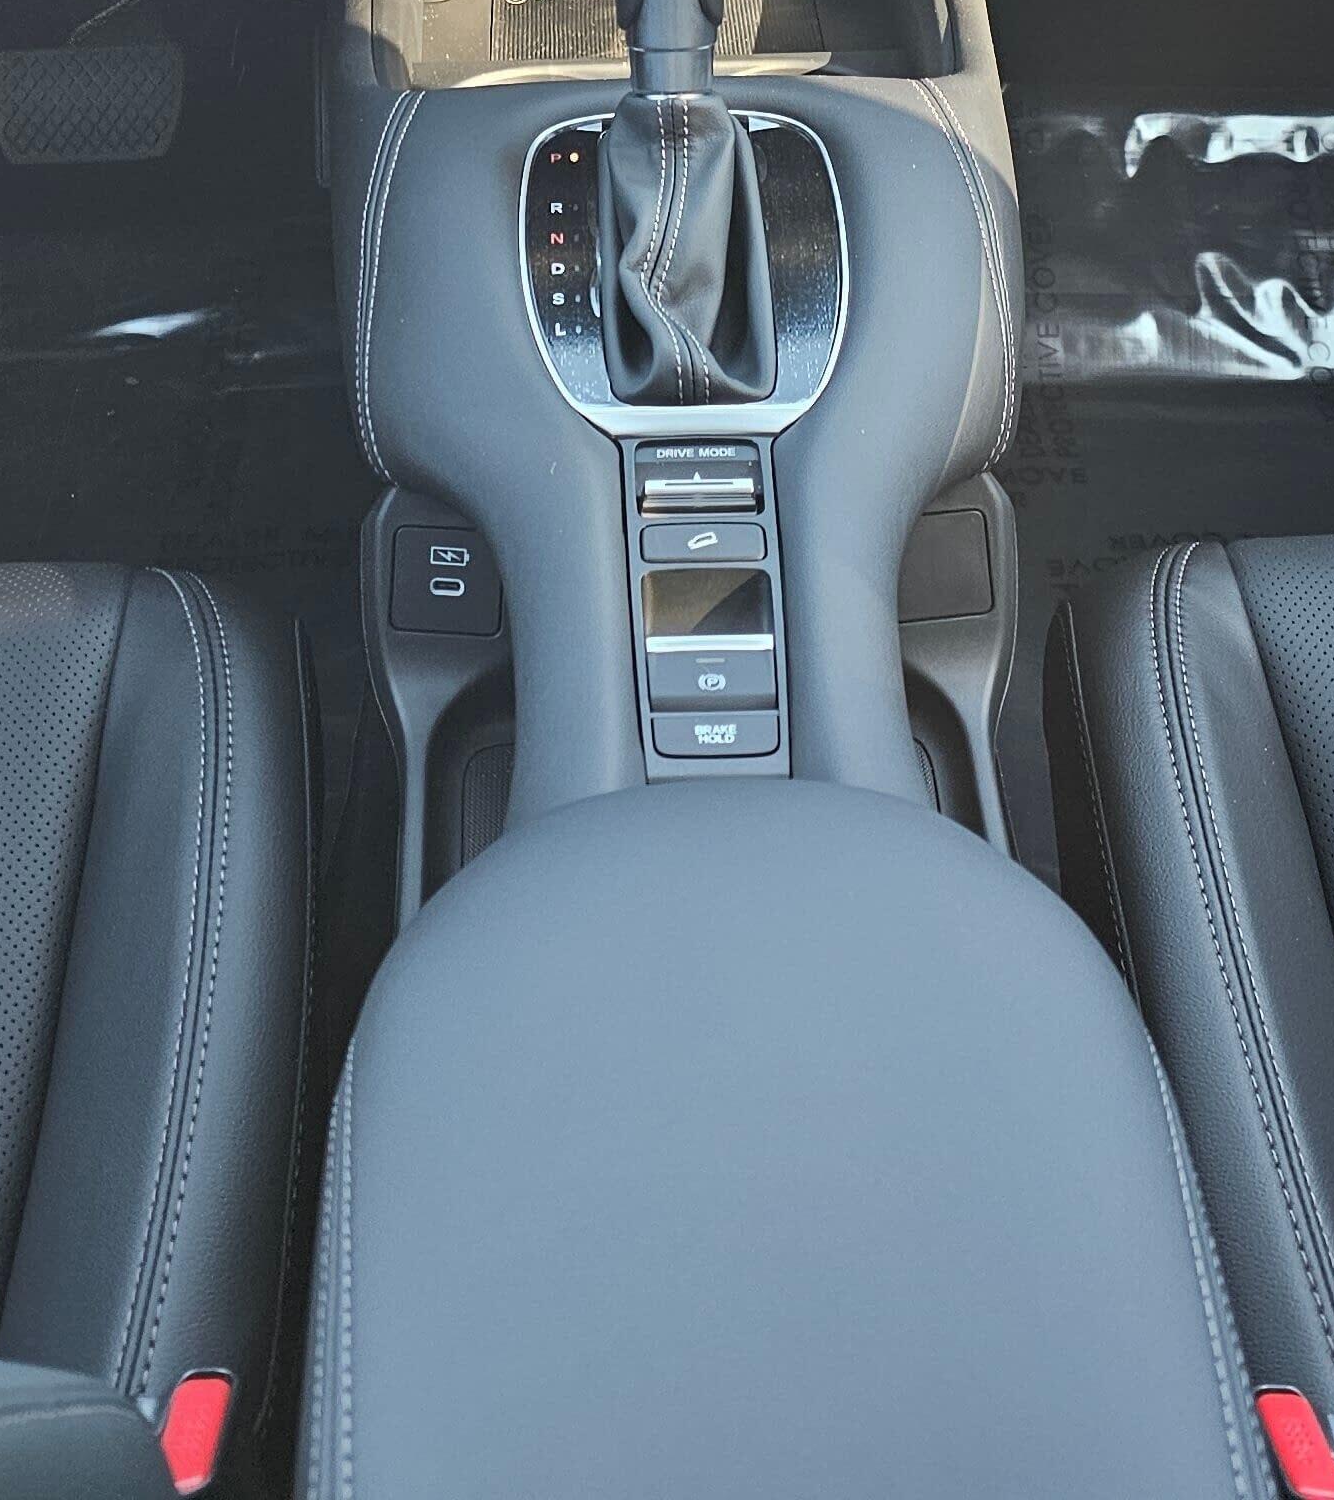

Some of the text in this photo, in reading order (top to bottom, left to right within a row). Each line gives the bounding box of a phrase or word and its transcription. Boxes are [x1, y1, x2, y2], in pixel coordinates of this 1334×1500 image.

[550, 153, 562, 164] P
[550, 202, 563, 213] R
[550, 232, 564, 244] N
[551, 263, 565, 275] D
[552, 293, 565, 306] S
[555, 322, 567, 337] L
[656, 447, 736, 459] DRIVE MODE
[694, 723, 737, 735] BRAKE
[697, 734, 736, 745] HOLD
